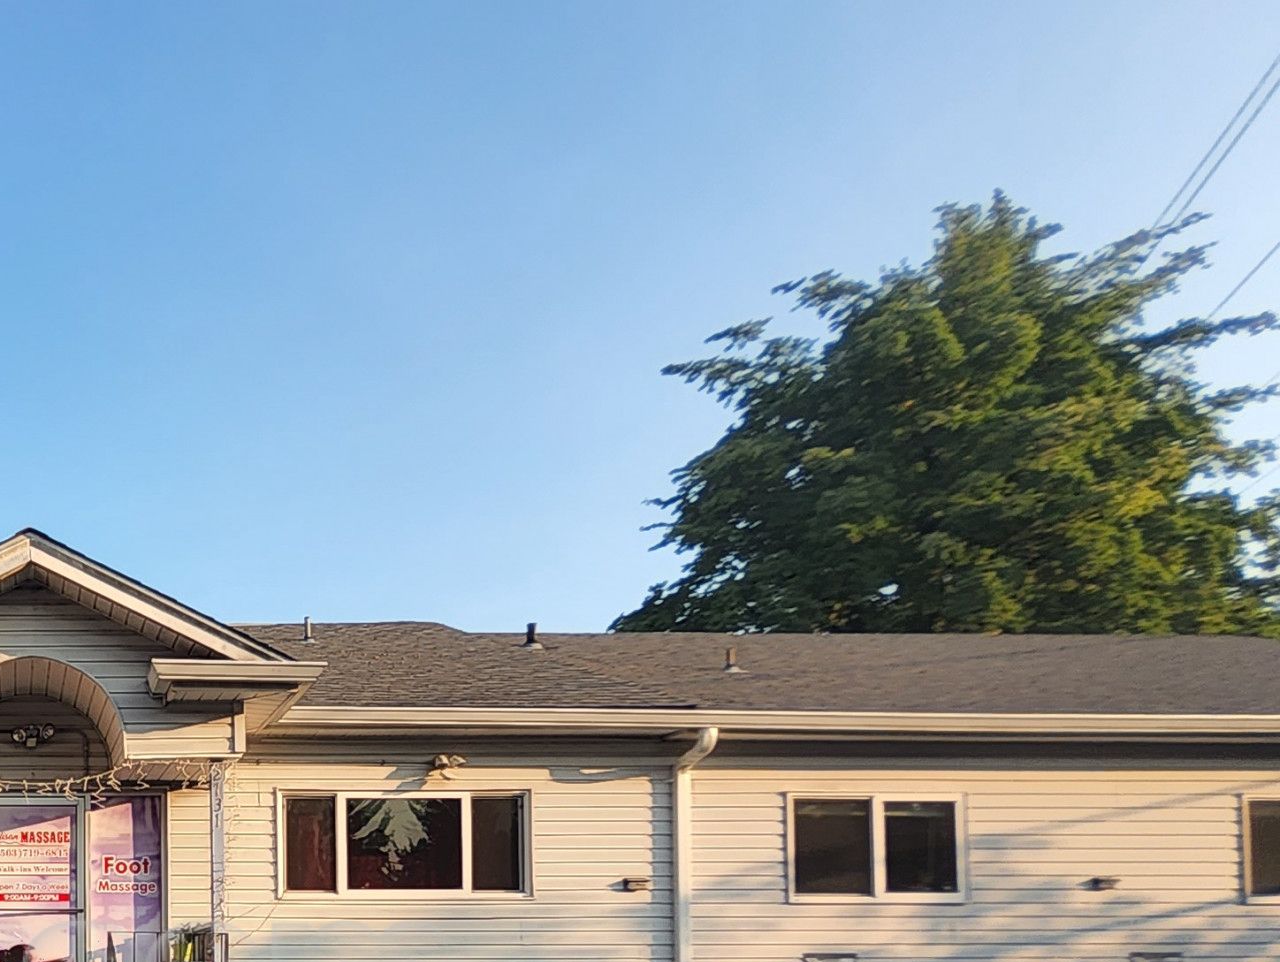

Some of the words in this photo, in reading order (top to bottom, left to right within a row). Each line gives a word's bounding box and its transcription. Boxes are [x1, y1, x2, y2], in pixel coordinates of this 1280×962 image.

[20, 831, 70, 843] MASSAGE
[103, 857, 150, 875] Foot
[98, 881, 156, 893] Massage
